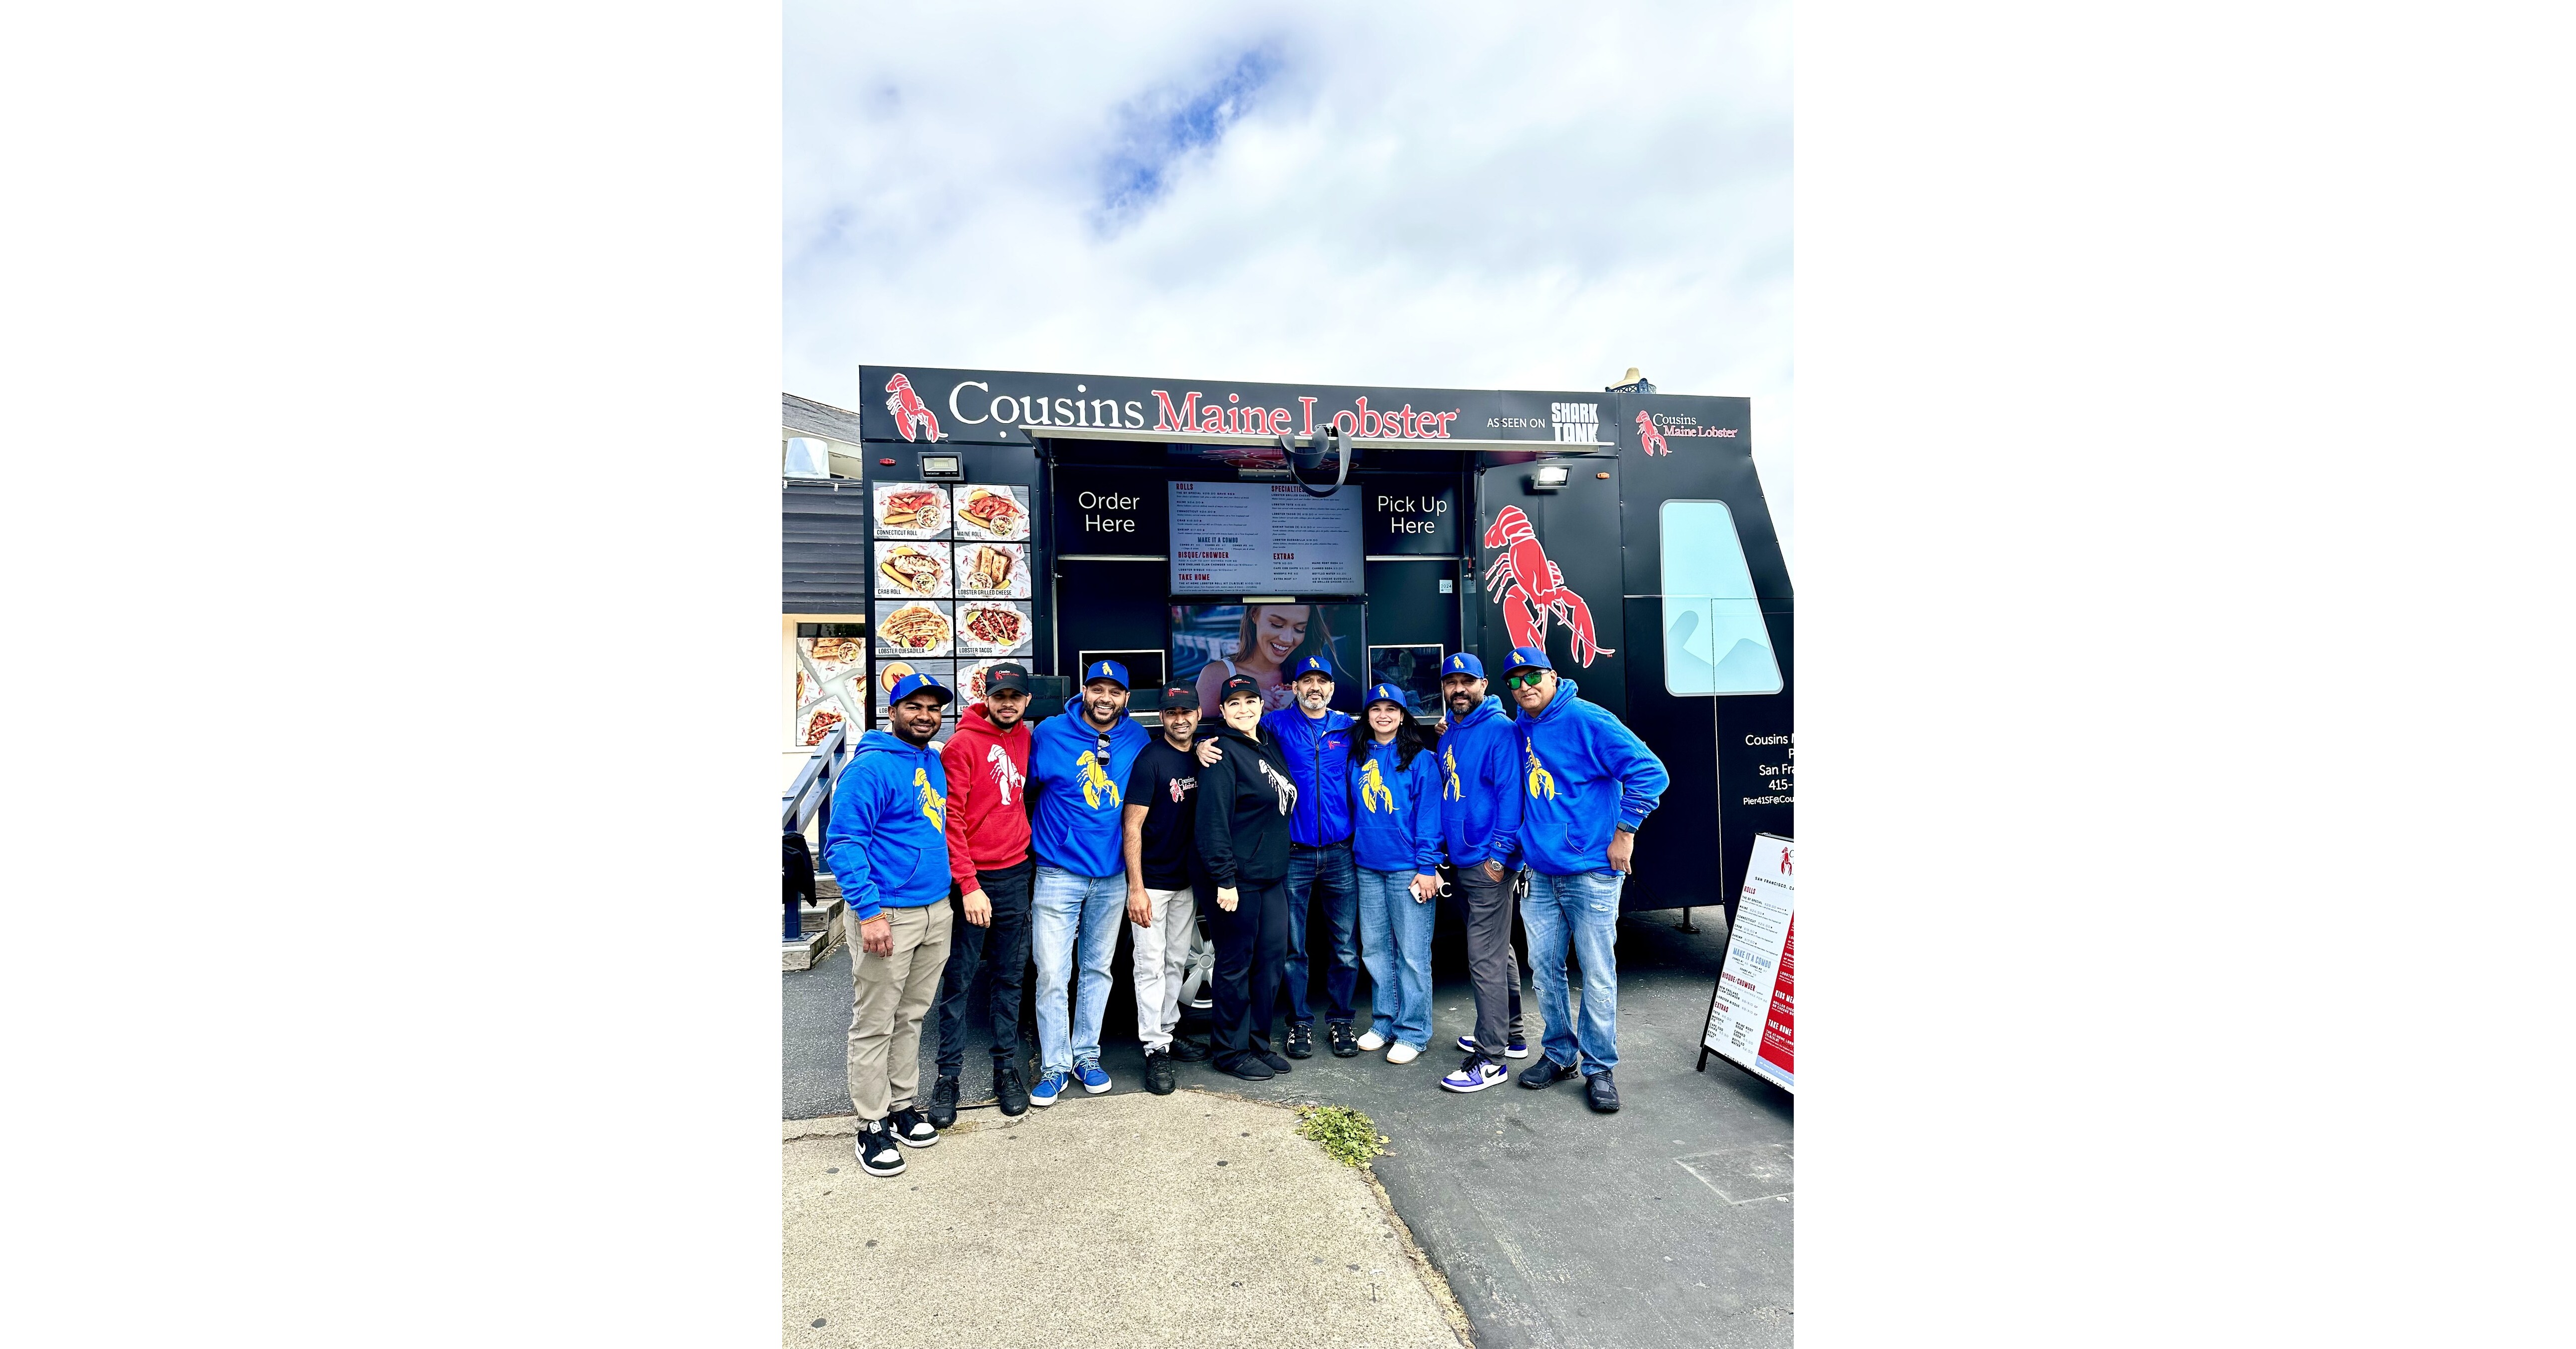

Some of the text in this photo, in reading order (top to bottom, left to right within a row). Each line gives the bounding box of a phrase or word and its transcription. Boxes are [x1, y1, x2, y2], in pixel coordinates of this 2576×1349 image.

[949, 381, 1145, 428] Cousins
[1151, 389, 1292, 436] Maine
[1551, 402, 1598, 423] SHARK
[1487, 418, 1545, 428] AS SEEN ON
[1652, 413, 1696, 427] Cousins
[1552, 423, 1598, 442] TANK
[1663, 425, 1737, 438] Maine Lobster
[1078, 491, 1140, 510] Order
[1378, 496, 1447, 517] Pick Up
[1085, 514, 1135, 532] Here
[1392, 517, 1435, 534] Here
[1745, 733, 1788, 745] Cousins
[1759, 764, 1779, 775] San
[1177, 776, 1194, 786] Cousins
[1744, 886, 1756, 894] ROLLS
[1737, 914, 1756, 923] CONNECTICUT
[1733, 947, 1745, 958] MAKE
[1755, 956, 1771, 968] COMBO
[1722, 972, 1756, 992] BISQUE/CHOWDER
[1726, 992, 1740, 1000] CHOWDER
[1775, 990, 1786, 1000] KIDS
[1715, 1001, 1729, 1013] EXTRAS
[1734, 1029, 1746, 1038] CANNED
[1768, 1019, 1792, 1036] TAKE HOME
[1732, 1037, 1745, 1046] BOTTLED
